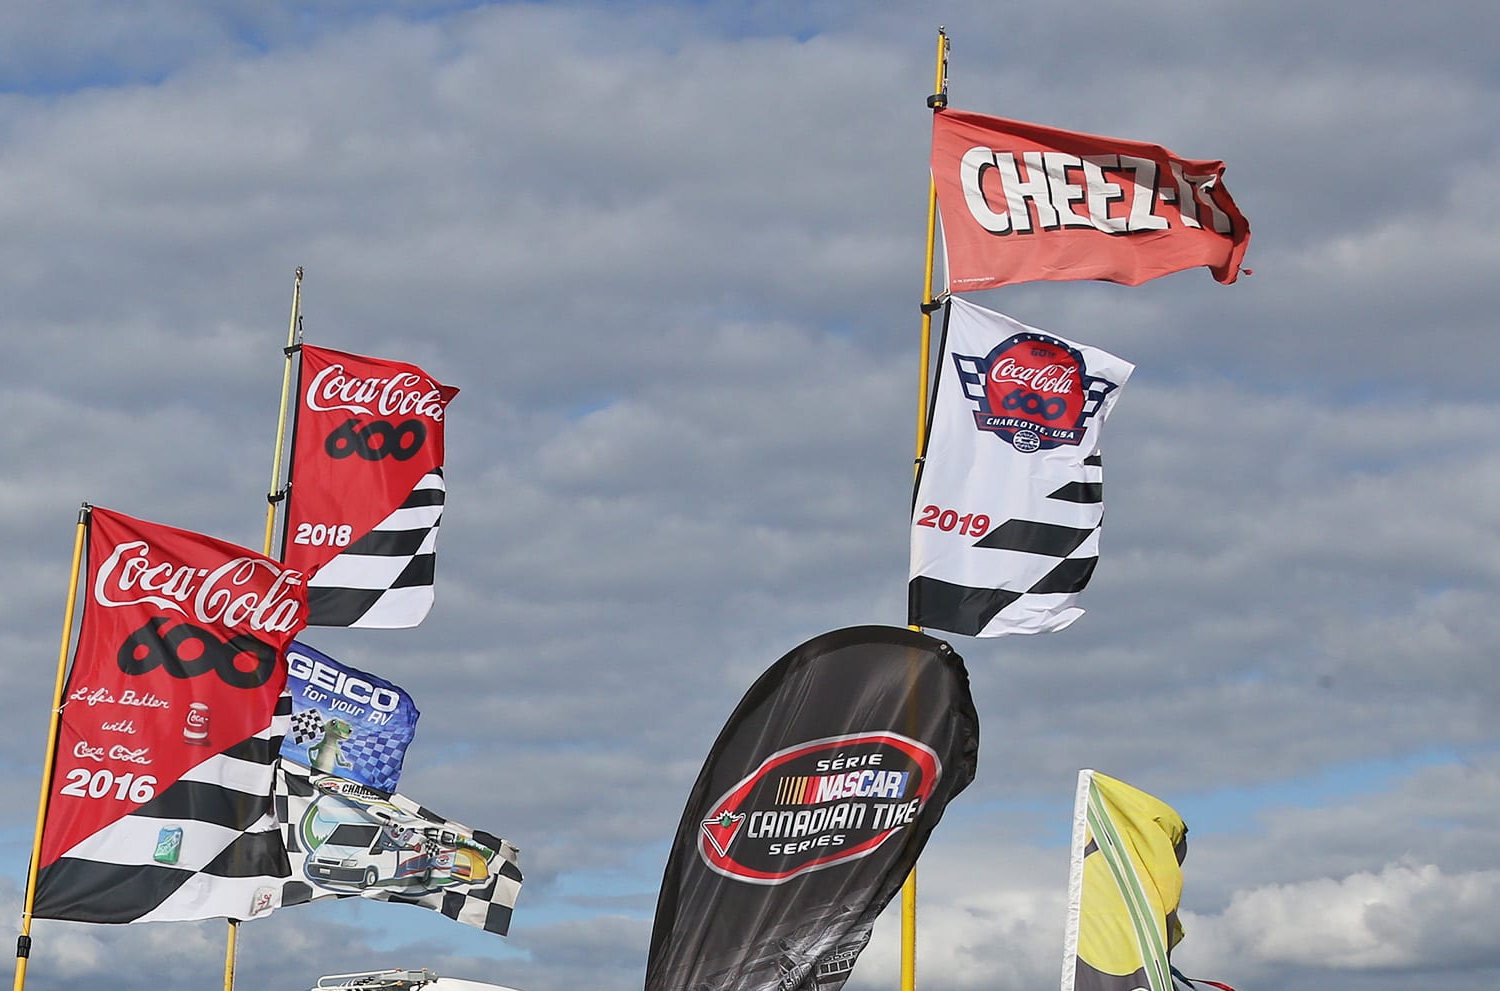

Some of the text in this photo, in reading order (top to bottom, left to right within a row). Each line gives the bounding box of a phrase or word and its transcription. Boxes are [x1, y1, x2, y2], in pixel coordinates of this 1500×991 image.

[991, 358, 1078, 394] Coca-Cola
[306, 364, 444, 422] Coca-Cola
[1002, 388, 1067, 421] 600
[325, 418, 428, 462] 600
[1052, 429, 1074, 439] USA
[293, 523, 353, 547] 2018
[916, 505, 991, 538] 2019
[94, 540, 303, 635] Coca-Cola
[116, 616, 275, 690] 600
[70, 686, 170, 709] Life's Better
[287, 651, 401, 714] GEICO
[301, 685, 393, 727] for your RV
[101, 719, 137, 735] with
[73, 741, 152, 765] Coca Cola
[815, 753, 883, 773] SÉRIE
[60, 769, 159, 805] 2016
[816, 770, 904, 803] NASCAR
[746, 796, 920, 840] CANADIAN TIRE
[768, 834, 845, 857] SERIES
